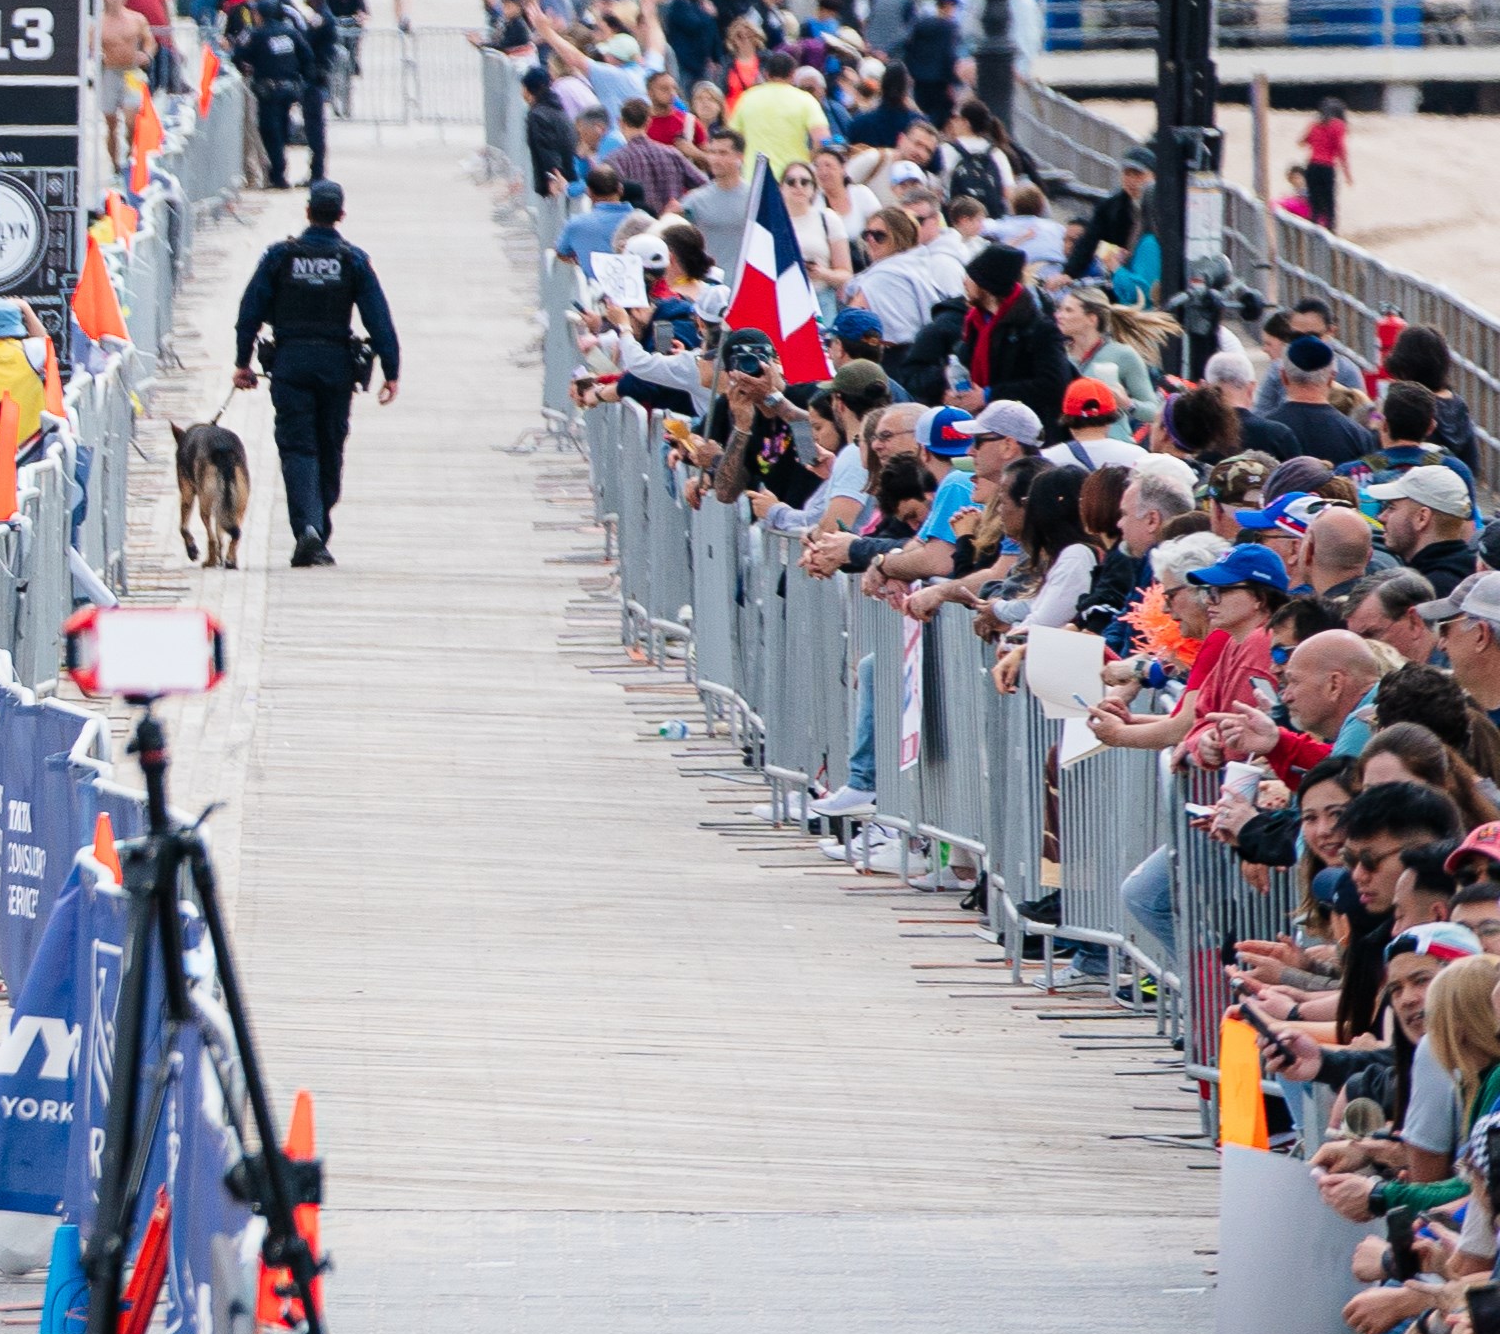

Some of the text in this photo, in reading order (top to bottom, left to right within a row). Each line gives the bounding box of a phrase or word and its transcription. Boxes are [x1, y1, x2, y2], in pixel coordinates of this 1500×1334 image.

[291, 257, 341, 274] NYPD
[8, 800, 33, 832] TATA
[0, 1098, 74, 1121] YORK
